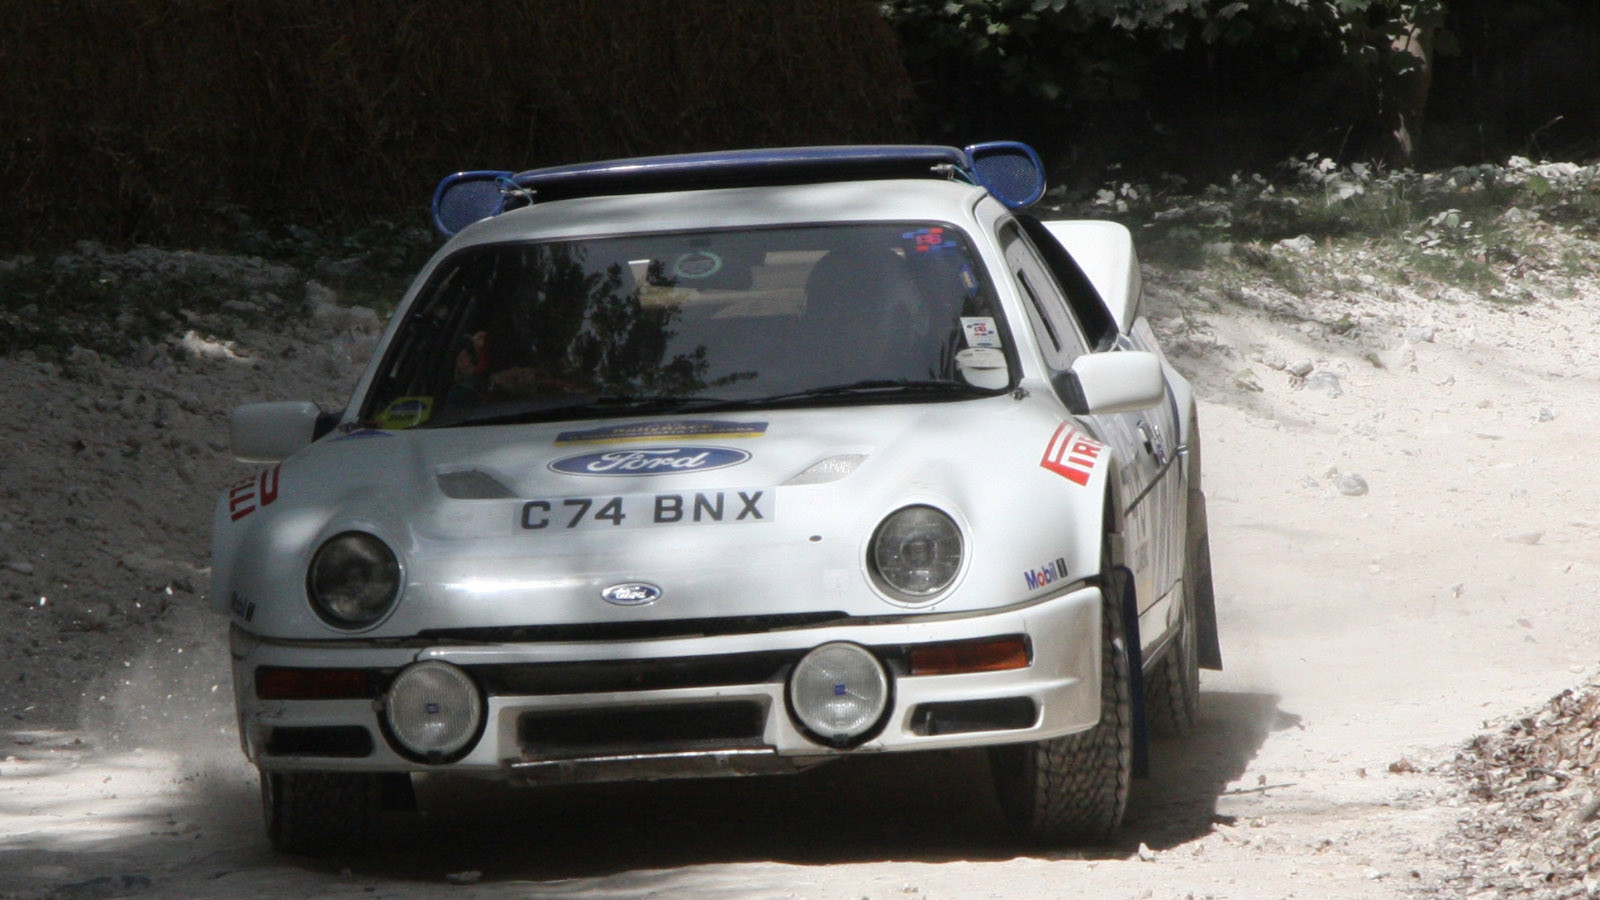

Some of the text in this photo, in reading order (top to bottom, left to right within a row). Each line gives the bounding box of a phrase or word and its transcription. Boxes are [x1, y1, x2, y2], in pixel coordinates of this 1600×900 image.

[587, 448, 710, 472] Ford
[520, 491, 765, 530] C74 BNX
[1024, 562, 1058, 591] Mobil
